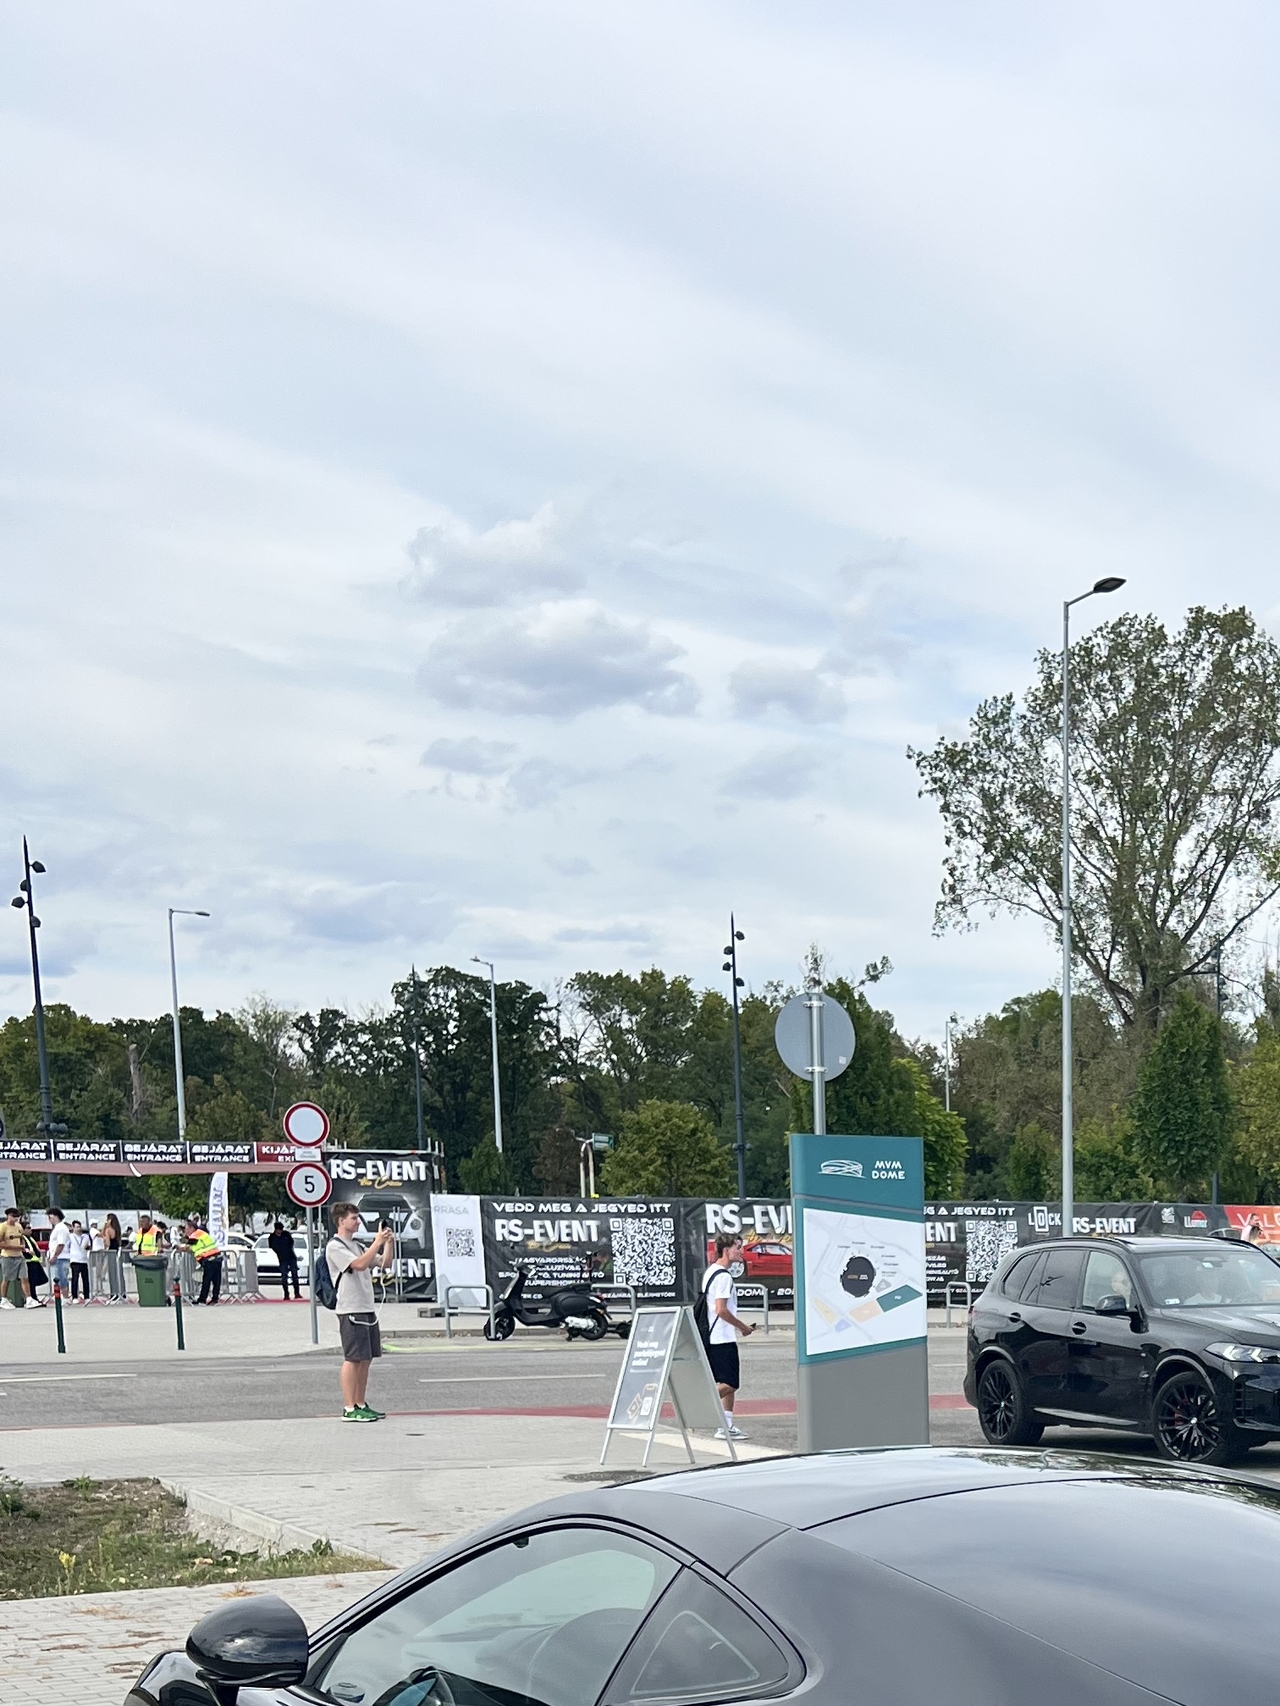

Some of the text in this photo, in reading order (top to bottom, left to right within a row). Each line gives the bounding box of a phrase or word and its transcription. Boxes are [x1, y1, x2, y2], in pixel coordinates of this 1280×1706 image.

[56, 1142, 117, 1152] BEJÁRAT
[124, 1143, 184, 1153] BEJÁRAT
[192, 1144, 251, 1154] BEJÁRAT
[59, 1153, 116, 1161] ENTRANCE
[127, 1154, 183, 1162] ENTRANCE
[194, 1154, 250, 1162] ENTRANCE
[330, 1159, 427, 1181] RS-EVENT
[875, 1160, 903, 1170] MVM
[871, 1170, 906, 1180] DOME
[304, 1175, 316, 1194] 5
[493, 1203, 671, 1213] VEDD MEG A JEGYED ITT
[951, 1206, 995, 1216] JEGYED
[705, 1203, 793, 1234] RS-EV
[1027, 1208, 1062, 1230] LOCK
[495, 1218, 600, 1242] RS-EVENT
[1072, 1217, 1137, 1234] RS-EVENT
